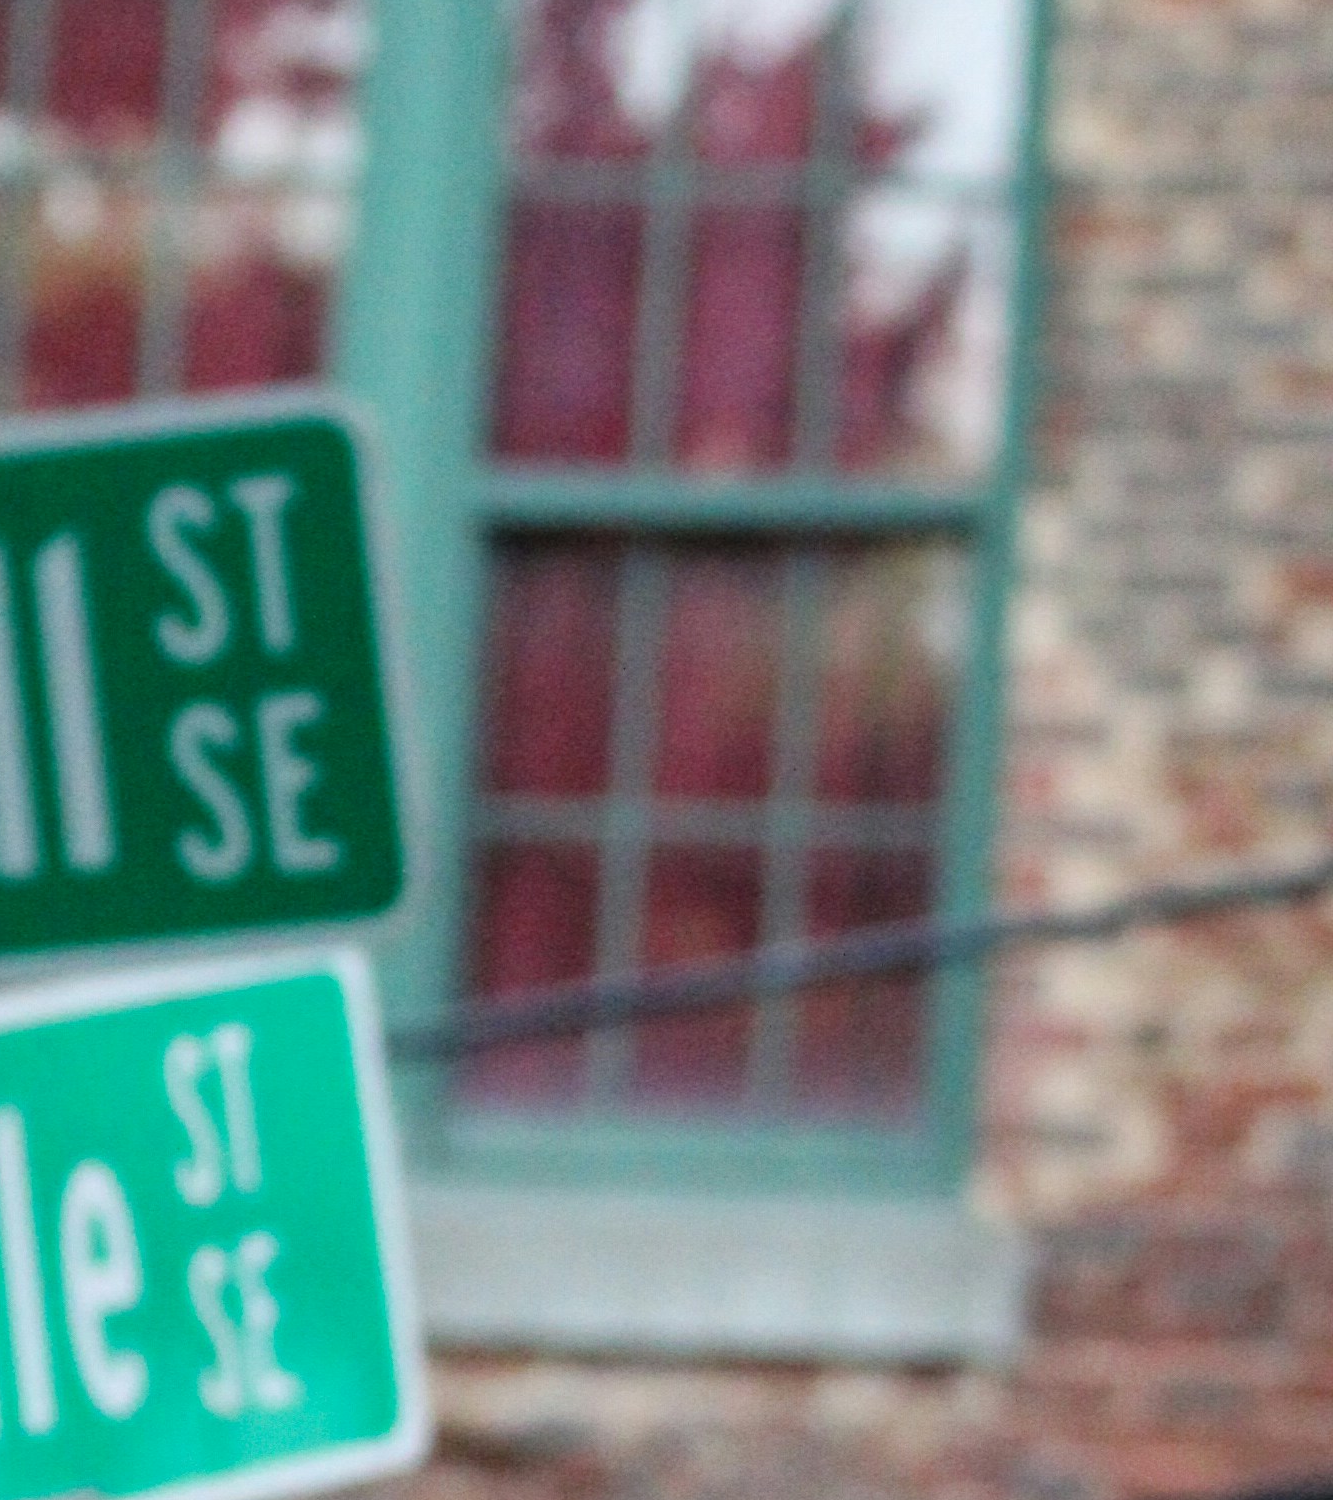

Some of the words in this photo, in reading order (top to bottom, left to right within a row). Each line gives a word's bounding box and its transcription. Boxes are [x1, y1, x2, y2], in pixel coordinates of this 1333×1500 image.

[146, 473, 296, 663] ST
[170, 694, 343, 882] SE
[163, 1023, 263, 1205] ST
[187, 1232, 299, 1416] SE
